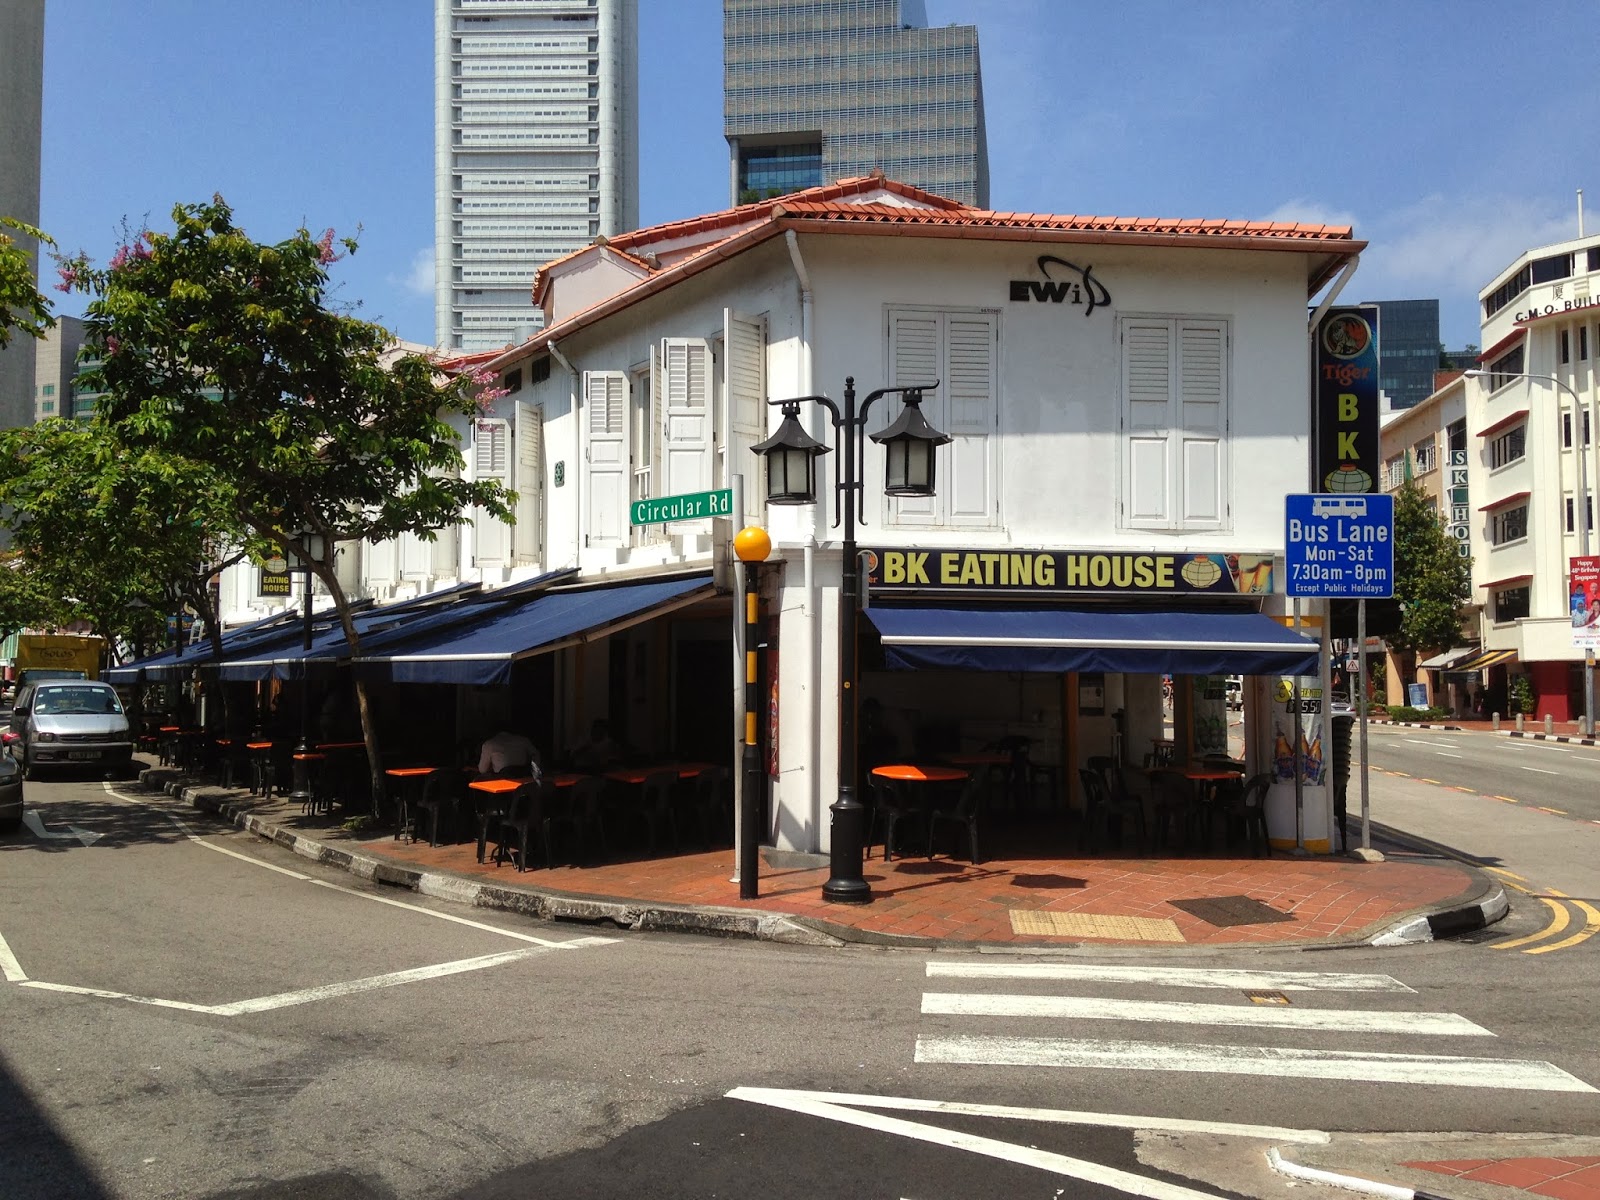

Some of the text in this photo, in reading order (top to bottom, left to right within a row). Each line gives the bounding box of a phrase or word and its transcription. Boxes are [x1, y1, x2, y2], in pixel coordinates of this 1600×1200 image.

[1322, 362, 1371, 386] Tiger
[637, 492, 728, 522] Circular Rd
[1289, 519, 1388, 543] Bus Lane
[263, 576, 289, 584] EATING
[884, 551, 1175, 588] BK EATING HOUSE
[263, 584, 290, 593] HOUSE
[1295, 583, 1384, 594] Except Public Holidays
